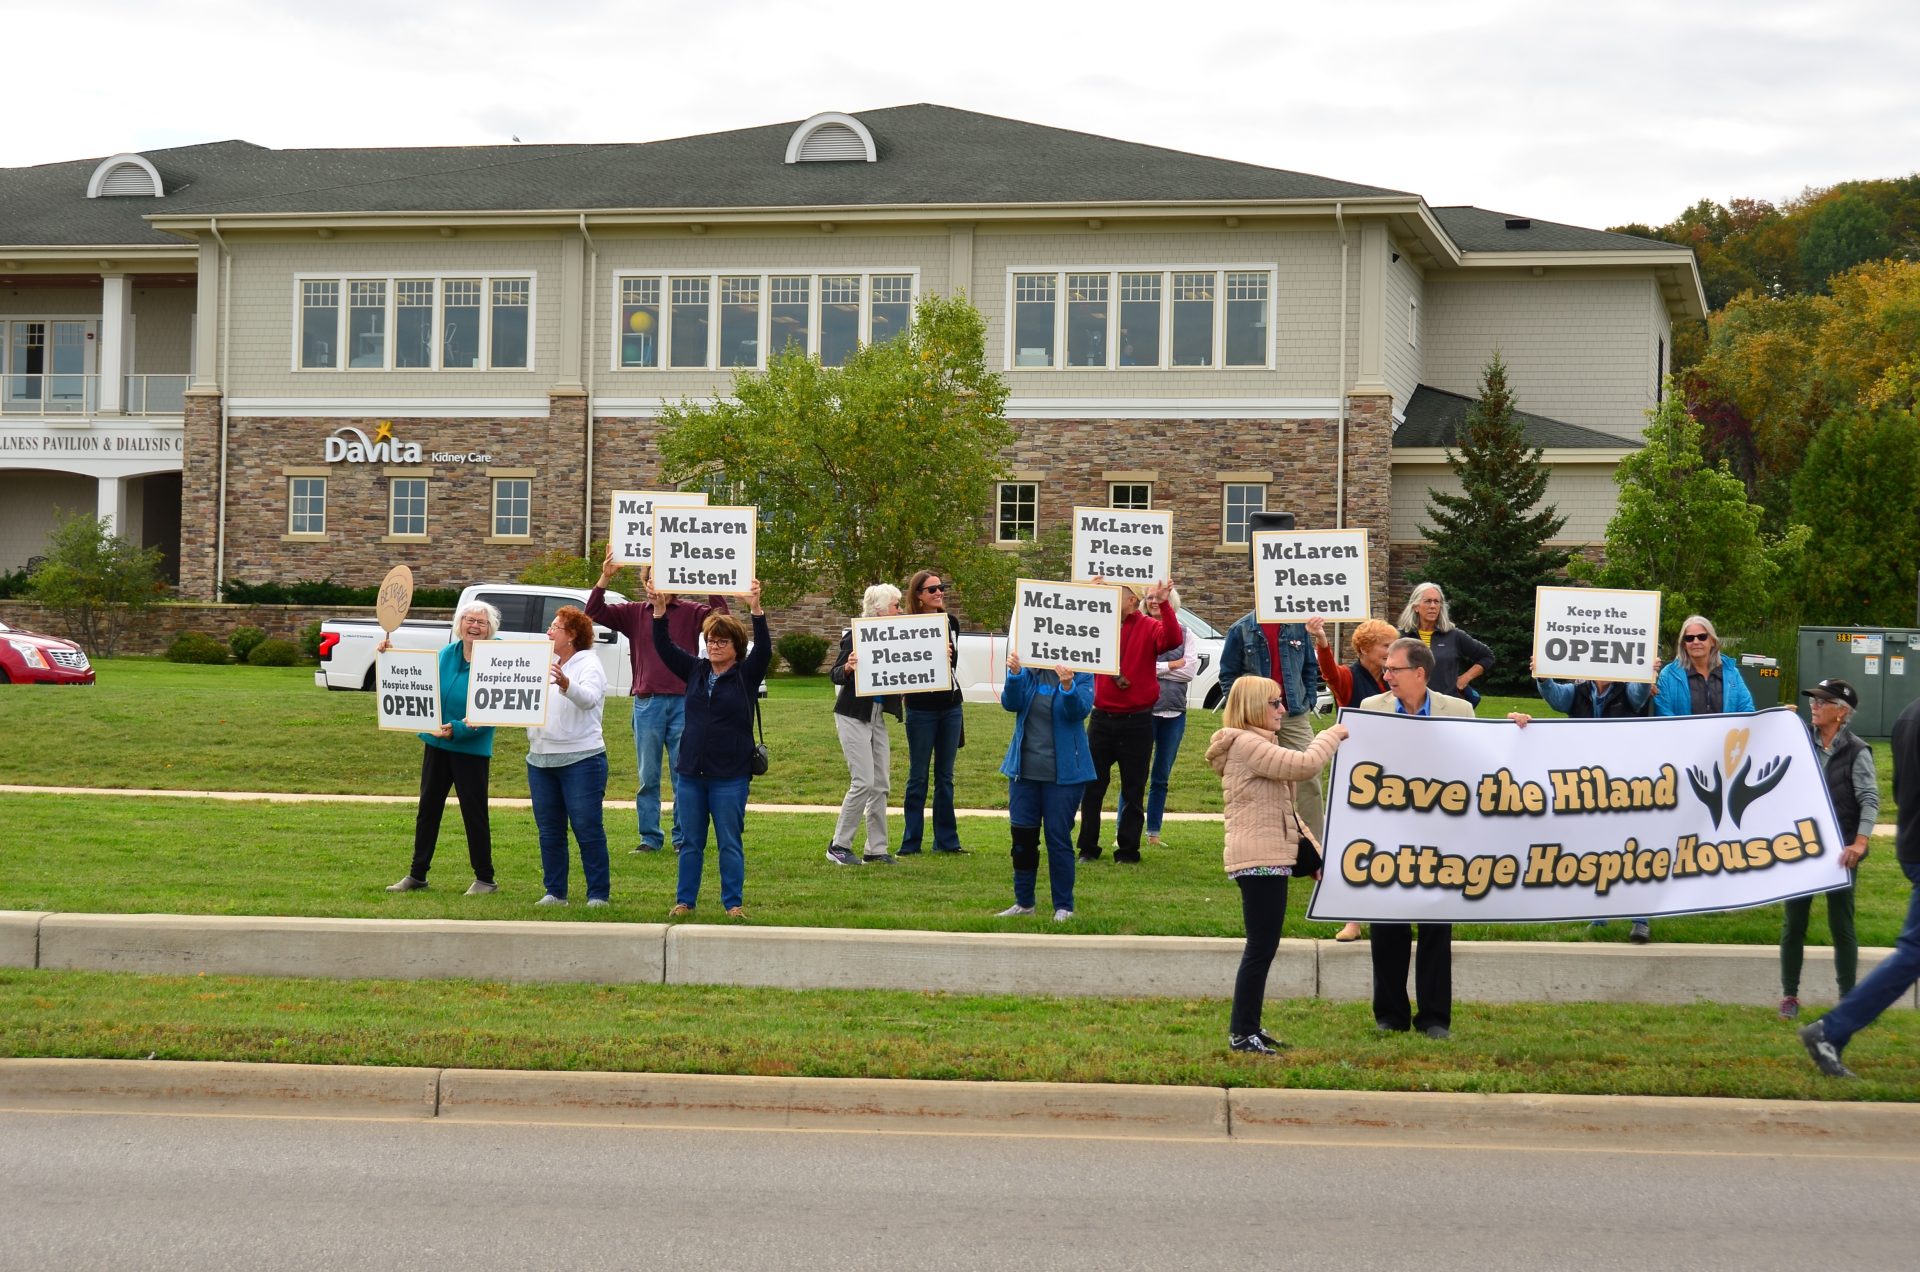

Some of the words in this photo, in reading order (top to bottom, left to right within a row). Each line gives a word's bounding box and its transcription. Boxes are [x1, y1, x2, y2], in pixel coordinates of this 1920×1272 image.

[0, 436, 39, 451] LNESS
[43, 436, 99, 451] PAVILION
[103, 437, 112, 451] &
[116, 437, 171, 451] DIALYSIS
[325, 426, 422, 463] DaVita
[431, 452, 466, 463] Kidney
[468, 452, 492, 462] Care
[660, 517, 747, 534] McLaren
[1081, 517, 1164, 535] McLaren
[670, 542, 736, 560] Please
[1090, 540, 1153, 556] Please
[1262, 542, 1358, 560] McLaren
[668, 567, 737, 585] Listen!
[1088, 561, 1153, 578] Listen!
[1275, 568, 1347, 586] Please
[1024, 591, 1112, 613] McLaren
[1274, 595, 1350, 612] Listen!
[1567, 606, 1602, 619] Keep
[1605, 608, 1628, 618] the
[860, 627, 941, 642] McLaren
[1033, 617, 1100, 638] Please
[1546, 622, 1600, 635] Hospice
[1603, 624, 1646, 636] House
[872, 648, 933, 664] Please
[1031, 642, 1101, 664] Listen!
[1545, 638, 1646, 665] OPEN!
[391, 665, 409, 676] Keep
[410, 666, 422, 675] the
[490, 657, 513, 668] Keep
[516, 657, 530, 667] the
[382, 680, 409, 691] Hospice
[410, 681, 433, 691] House
[476, 673, 512, 685] Hospice
[513, 673, 542, 683] House
[871, 669, 935, 686] Listen!
[383, 694, 434, 718] OPEN!
[474, 688, 541, 711] OPEN!
[1347, 760, 1468, 814] Save
[1477, 767, 1547, 816] the
[1547, 762, 1677, 814] Hiland
[1341, 838, 1521, 900] Cottage
[1522, 837, 1671, 896] Hospice
[1672, 817, 1825, 878] House!
